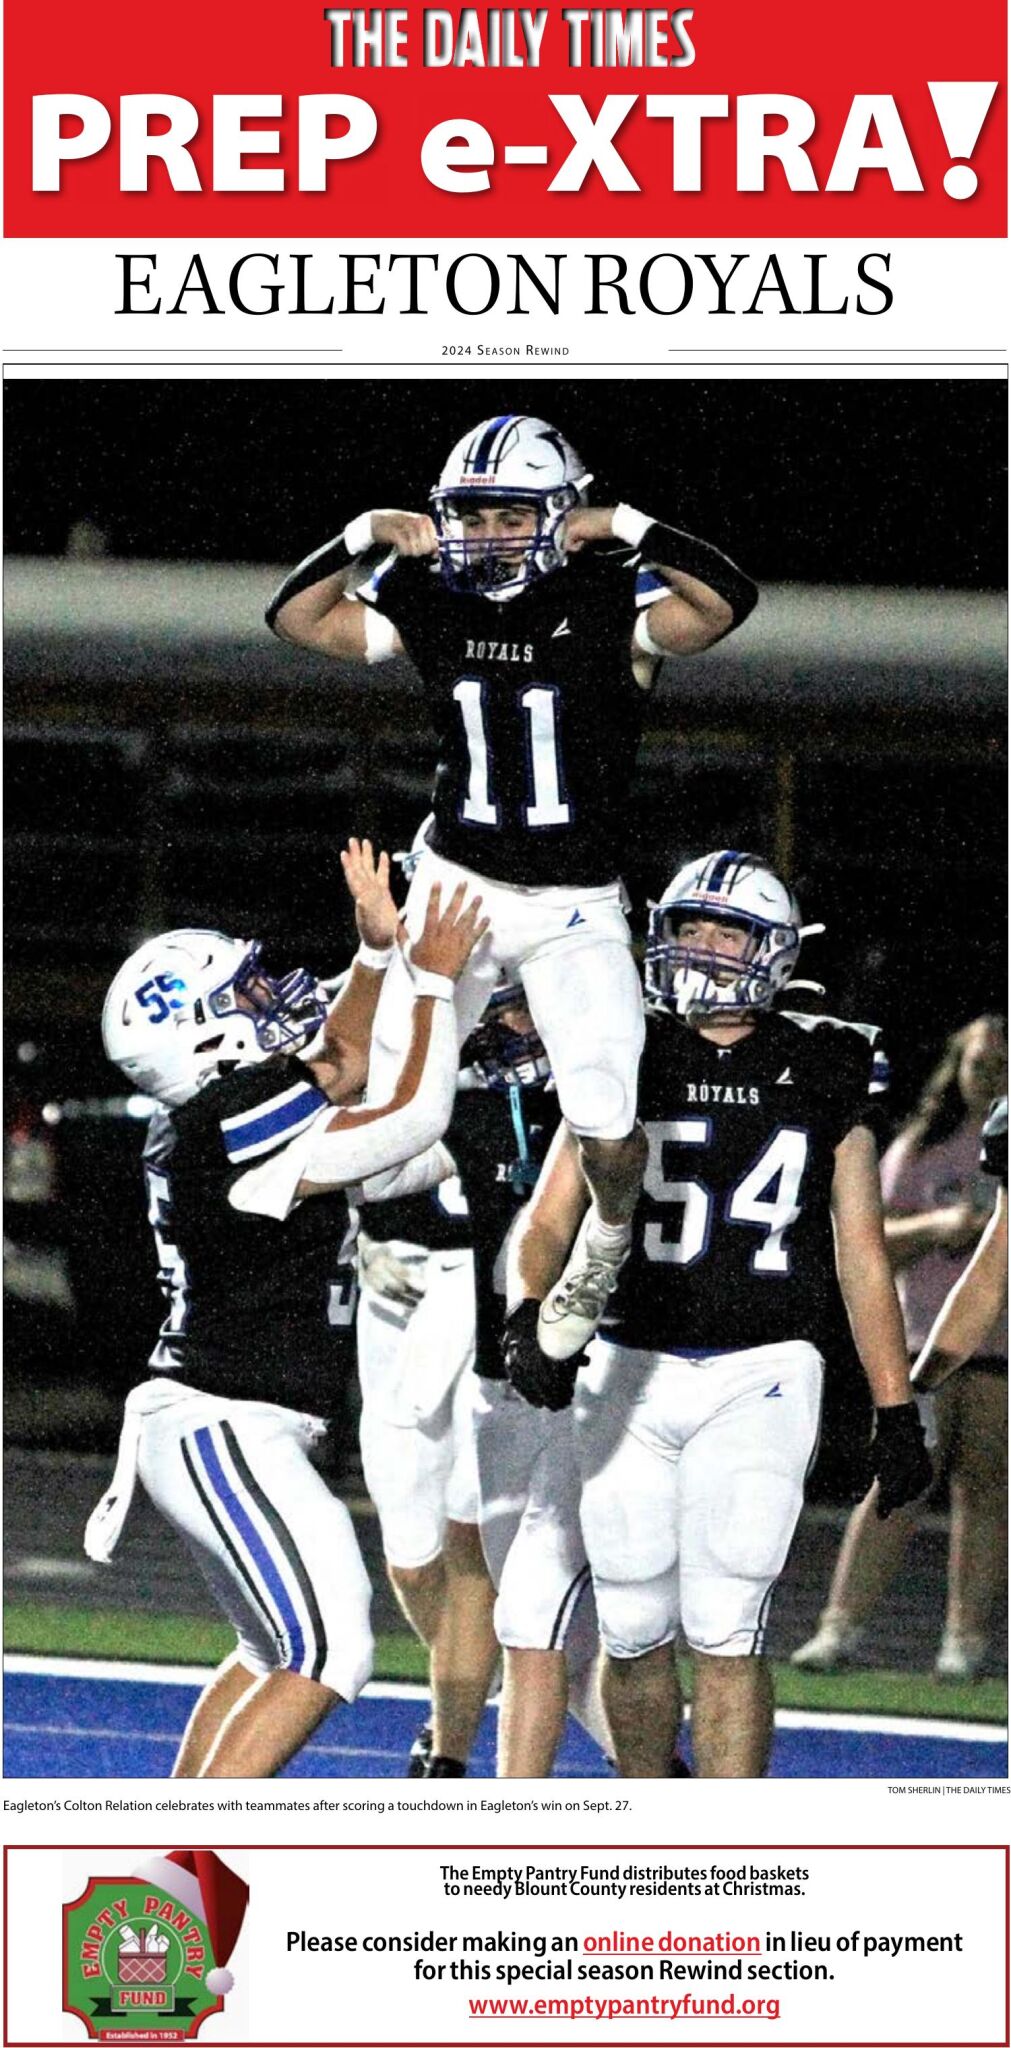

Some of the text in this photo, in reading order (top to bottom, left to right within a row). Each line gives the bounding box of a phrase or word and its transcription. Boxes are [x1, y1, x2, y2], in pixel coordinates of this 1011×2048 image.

[465, 638, 534, 663] ROYALS
[452, 678, 571, 828] 11
[134, 971, 185, 1023] 55
[687, 1082, 760, 1105] ROYALS
[643, 1117, 808, 1273] 54
